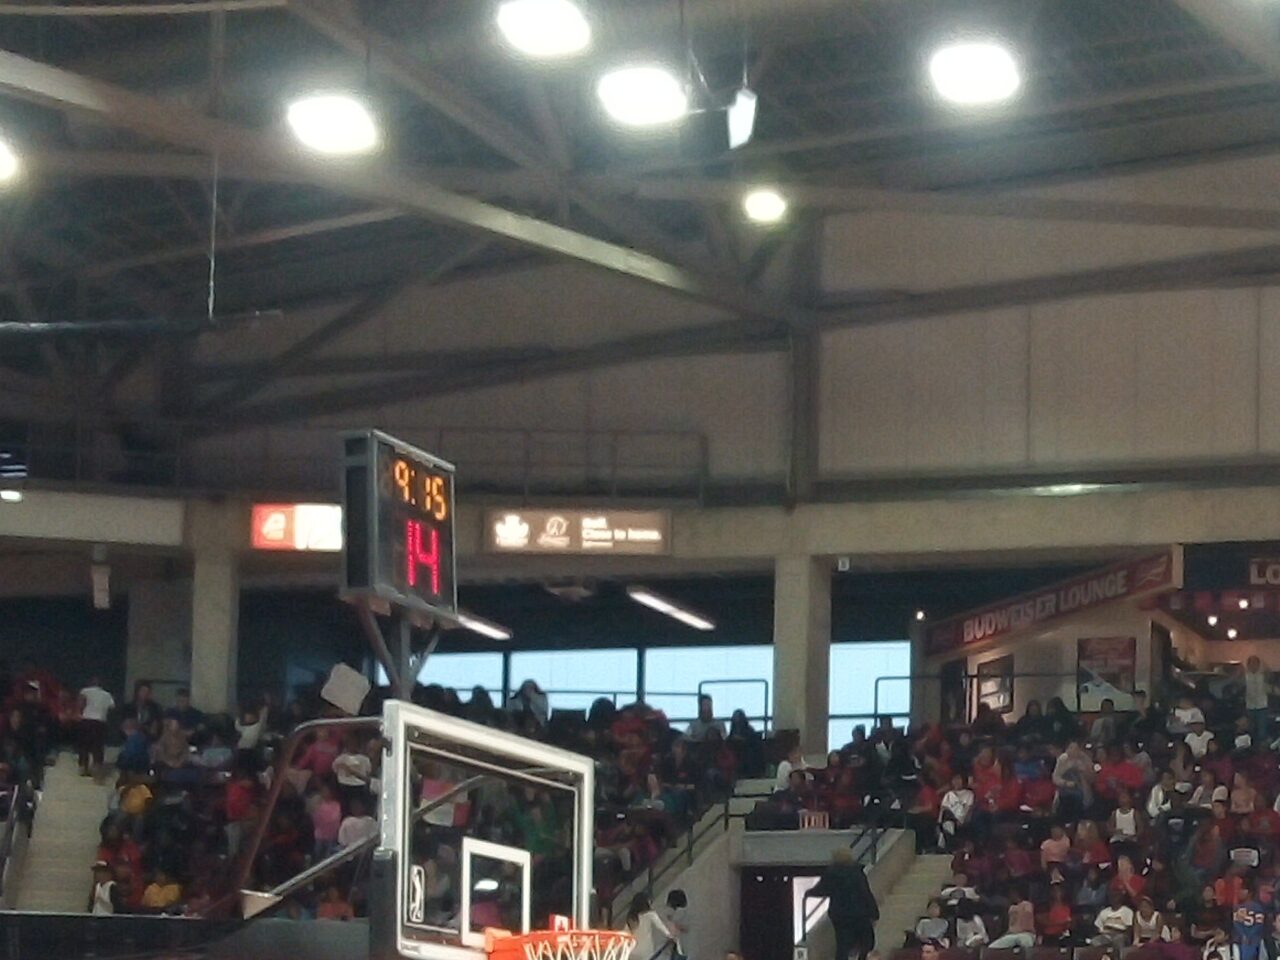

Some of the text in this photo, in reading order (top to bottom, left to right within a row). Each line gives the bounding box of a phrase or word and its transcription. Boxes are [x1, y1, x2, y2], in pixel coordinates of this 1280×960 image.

[394, 459, 447, 521] 9:15
[963, 569, 1129, 643] BUDWEISER LOUNGE
